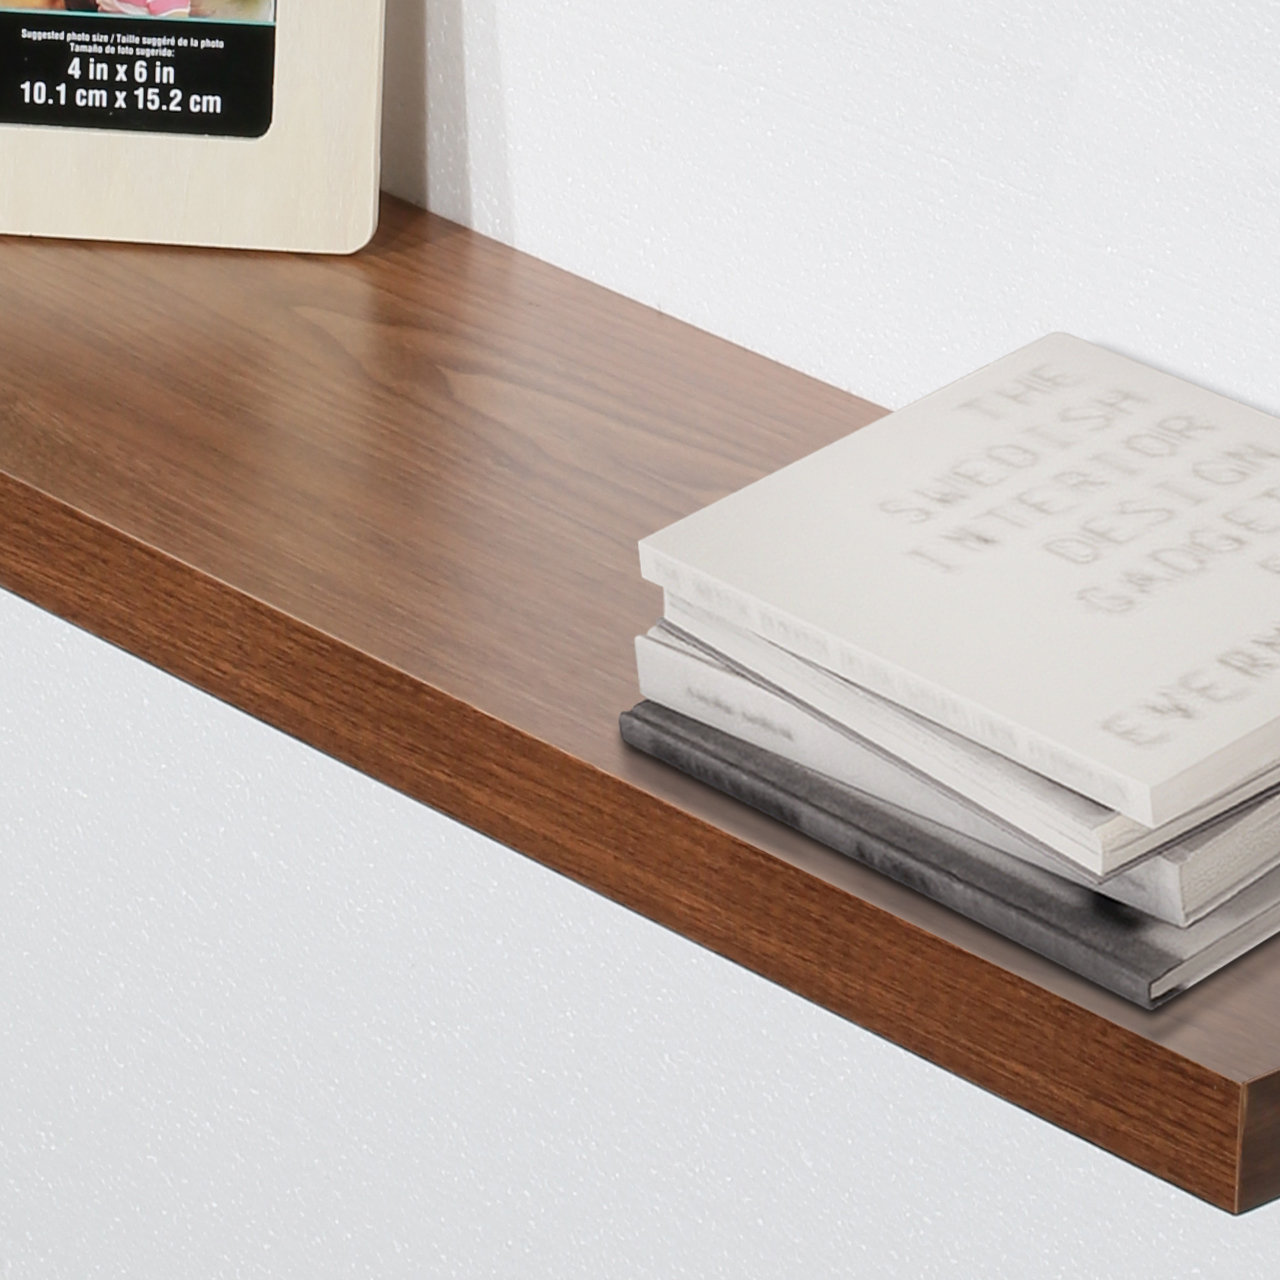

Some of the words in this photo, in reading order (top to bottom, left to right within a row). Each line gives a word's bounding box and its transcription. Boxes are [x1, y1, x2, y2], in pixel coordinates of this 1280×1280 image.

[21, 28, 65, 41] Suggested
[66, 32, 90, 43] photo
[91, 33, 109, 43] size
[116, 33, 140, 45] Taille
[177, 37, 188, 46] de
[190, 38, 199, 48] la
[200, 39, 224, 49] photo
[70, 42, 103, 54] Tamaño
[105, 44, 115, 54] de
[117, 44, 134, 56] foto
[136, 46, 175, 58] sugerido:
[67, 57, 81, 80] 4
[89, 58, 108, 81] in
[115, 64, 128, 82] x
[134, 60, 148, 83] 6
[155, 61, 175, 85] in
[20, 80, 66, 106] 10.1
[75, 88, 107, 108] cm
[114, 90, 127, 109] x
[134, 87, 182, 112] 15.2
[189, 94, 221, 113] cm
[953, 363, 1084, 421] THE
[878, 389, 1151, 525] SWEDISH
[904, 415, 1216, 572] INTERIOR
